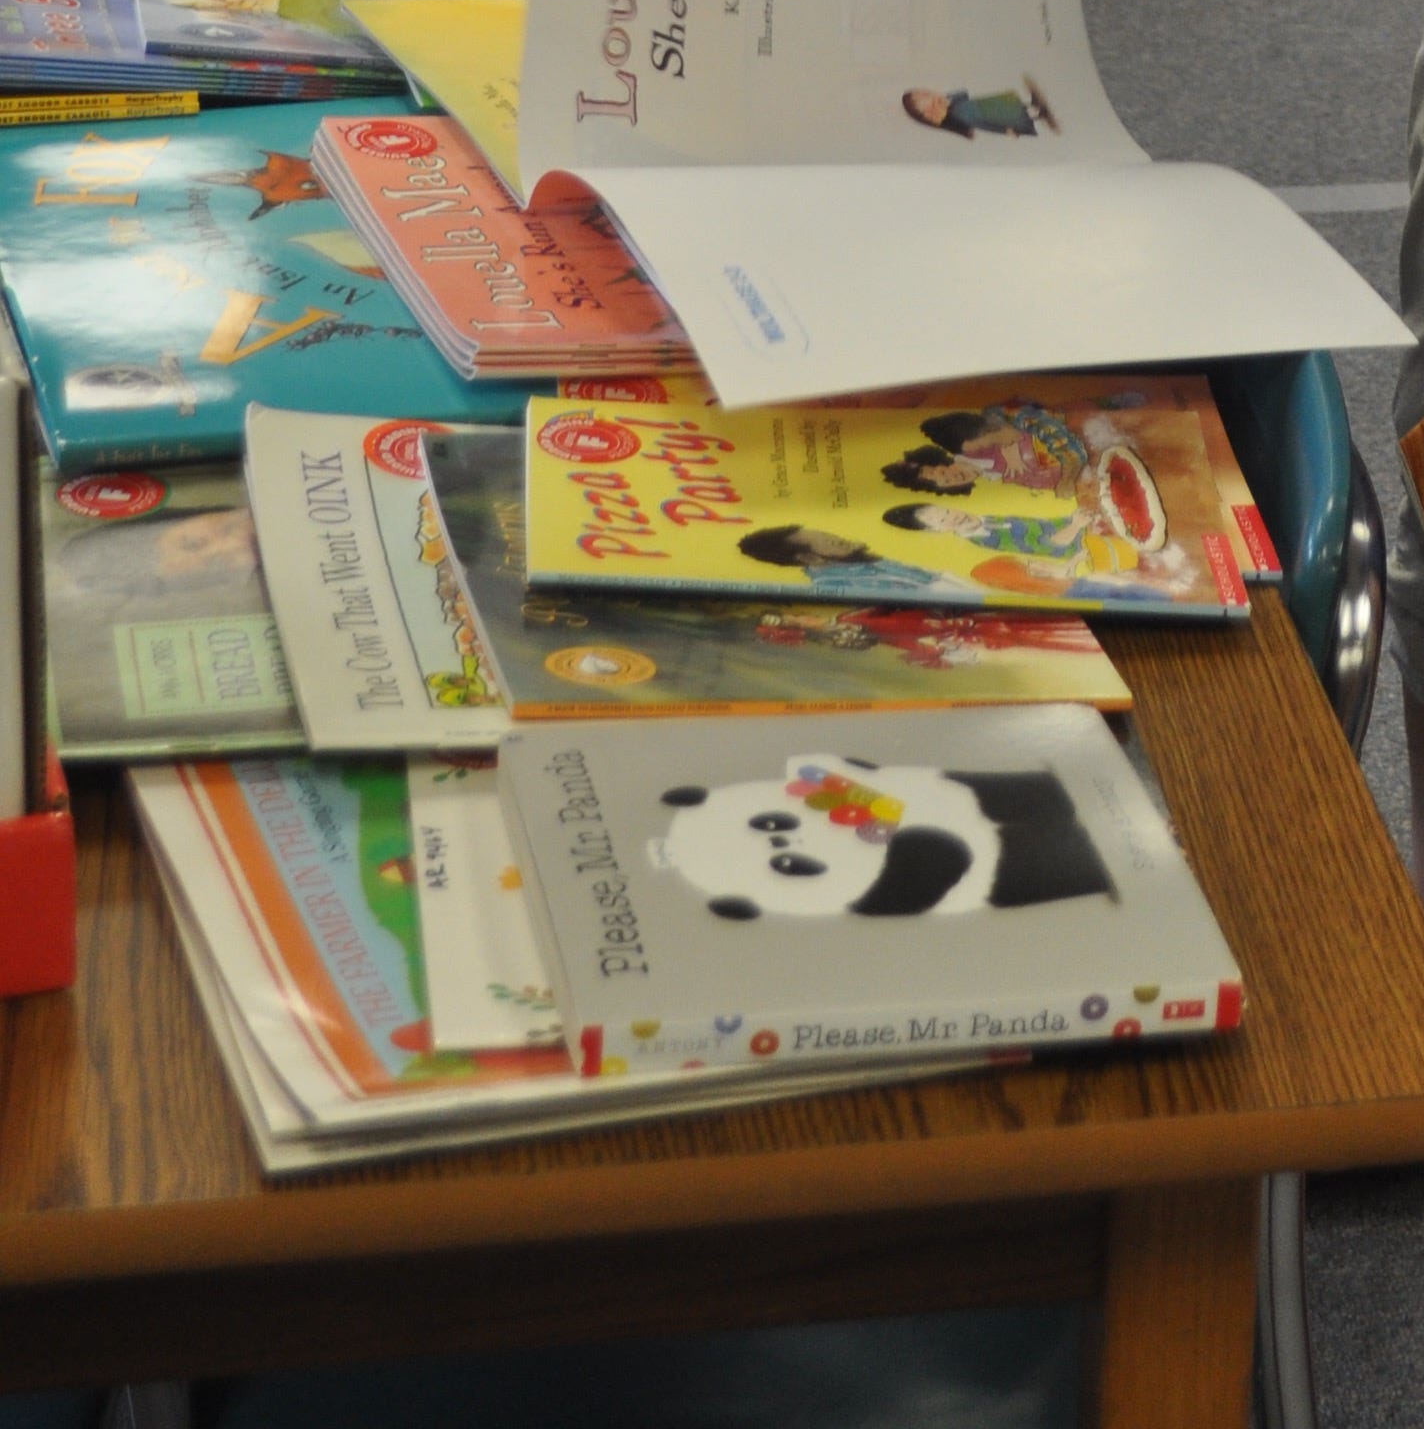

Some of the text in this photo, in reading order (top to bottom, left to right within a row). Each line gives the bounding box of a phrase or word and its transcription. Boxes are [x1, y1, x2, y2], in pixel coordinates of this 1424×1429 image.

[33, 131, 172, 207] Fox
[380, 153, 565, 331] Louella Mae
[519, 220, 566, 259] Run
[321, 280, 374, 306] An
[536, 262, 606, 309] She's
[199, 290, 346, 366] A
[577, 434, 609, 449] F
[97, 486, 132, 501] F
[614, 415, 753, 527] Party!
[566, 470, 672, 560] Pizza
[300, 449, 404, 711] The Cow That Went OINK
[1205, 535, 1236, 600] SCHOLASTIC
[206, 628, 261, 700] BREAD
[551, 748, 603, 825] Panda
[269, 816, 317, 863] THE
[569, 829, 618, 873] Mr
[288, 864, 332, 891] IN
[303, 890, 380, 983] FARMER
[349, 981, 402, 1028] THE
[908, 1016, 958, 1042] Mr
[970, 1009, 1070, 1037] Panda
